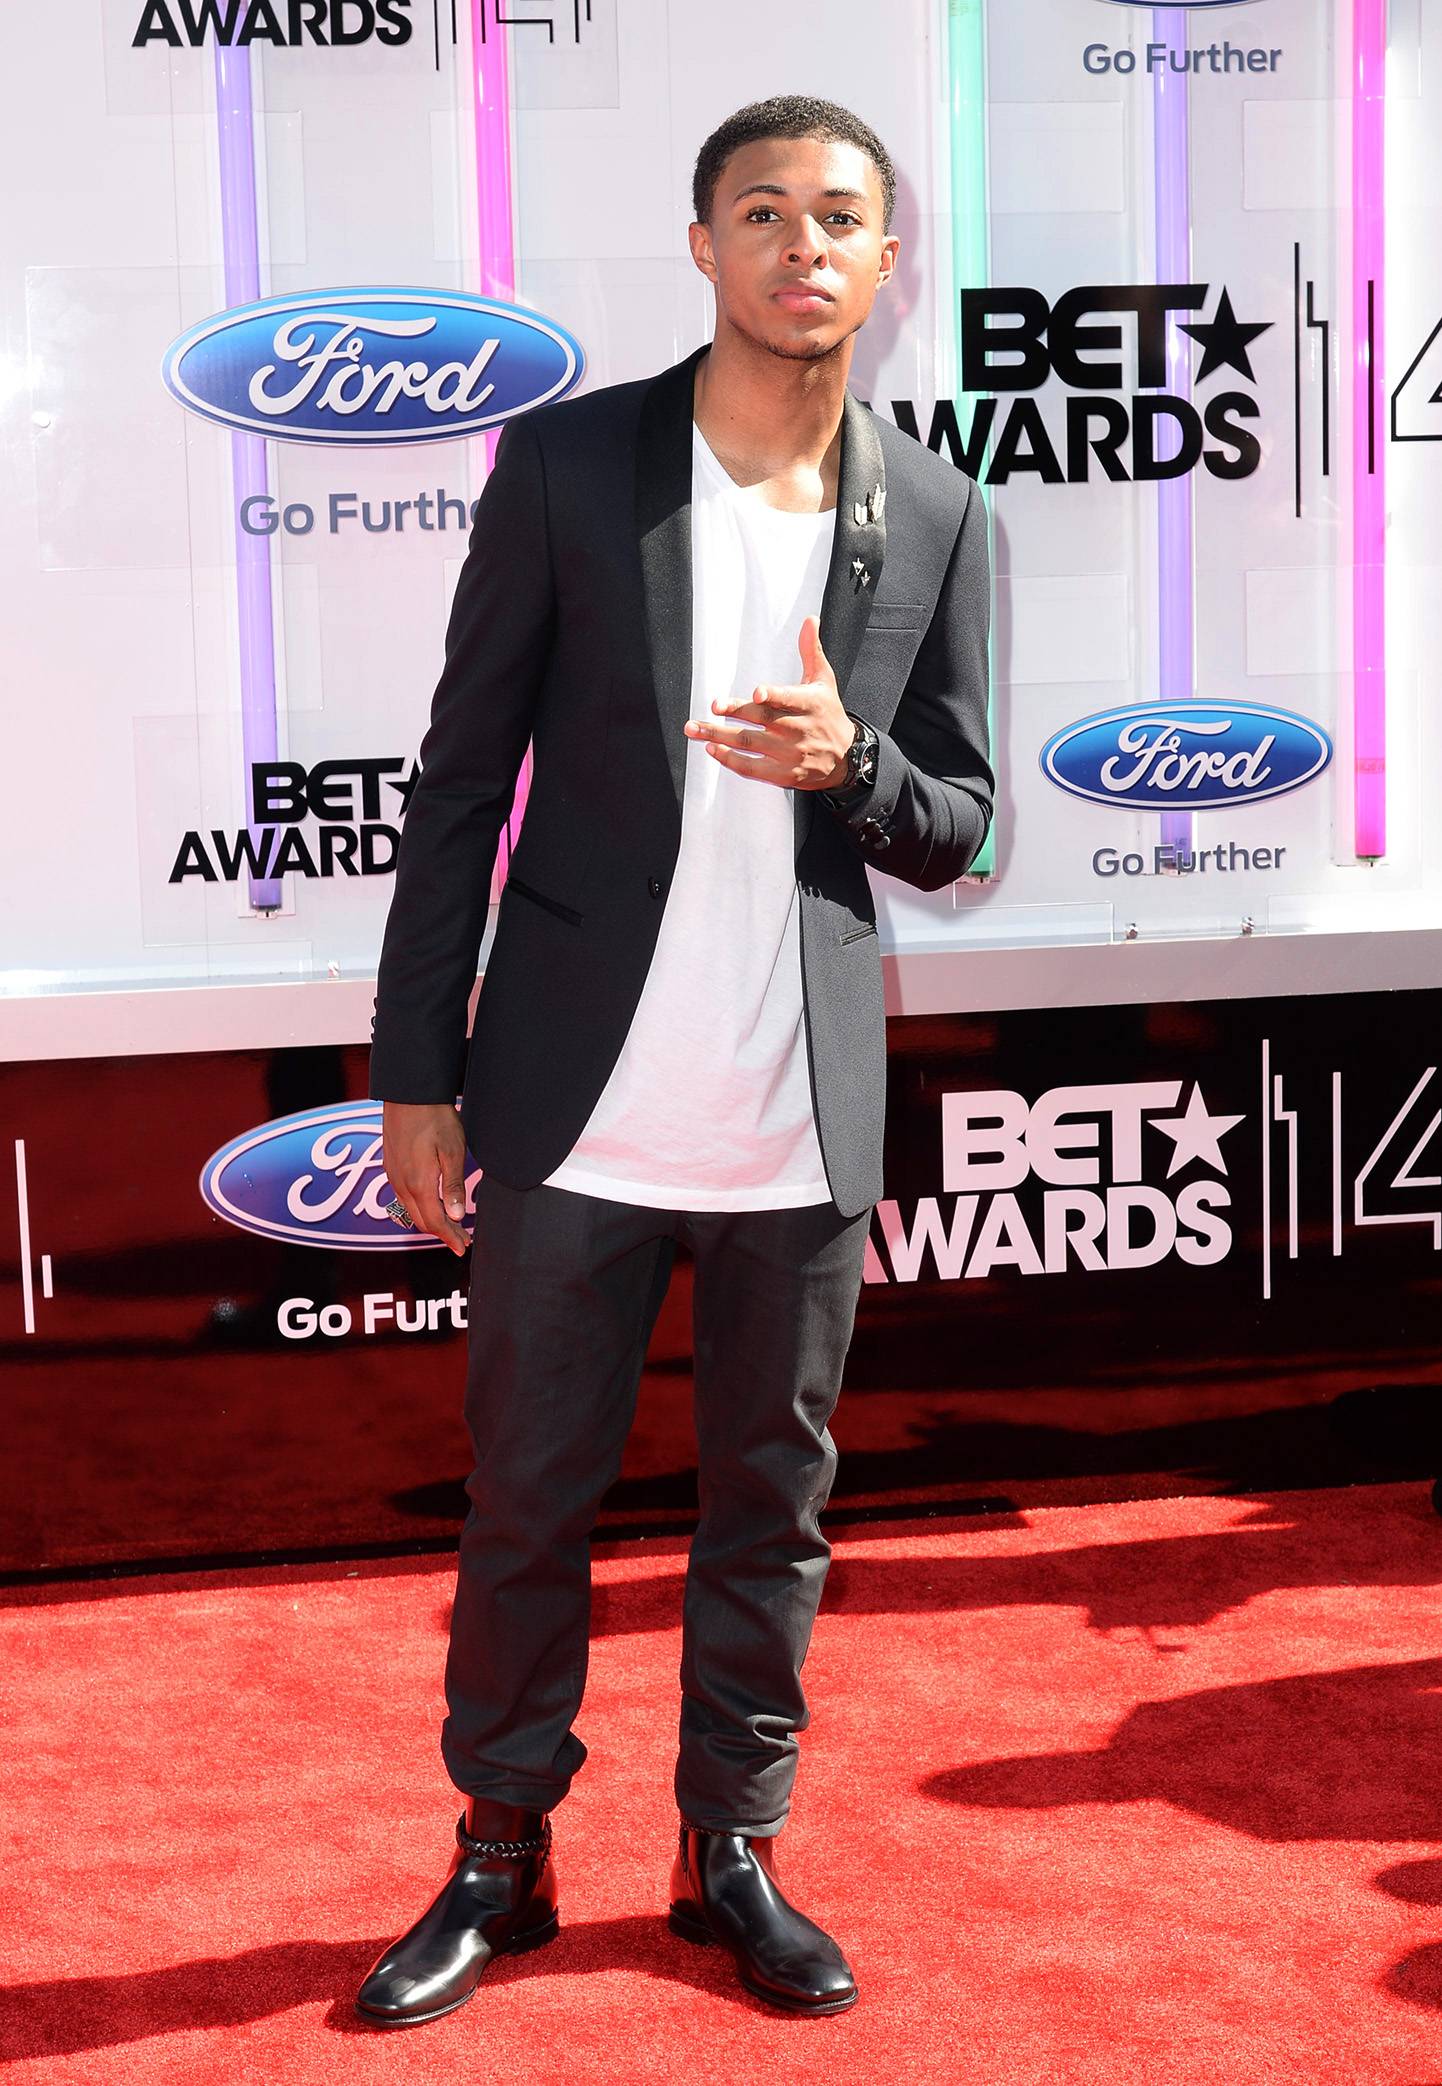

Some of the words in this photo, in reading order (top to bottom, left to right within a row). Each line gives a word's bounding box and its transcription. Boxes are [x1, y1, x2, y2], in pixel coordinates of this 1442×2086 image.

[132, 0, 413, 47] AWARDS
[1083, 43, 1136, 74] Go
[1146, 41, 1282, 73] Further
[249, 313, 500, 415] Ford
[960, 284, 1209, 392] BET
[858, 391, 1261, 485] WARDS
[239, 495, 315, 536] Go
[328, 488, 481, 534] Furth
[1100, 719, 1276, 792] Ford
[252, 757, 405, 824] BET
[168, 823, 402, 883] AWARD
[1092, 847, 1144, 877] Go
[1154, 841, 1286, 875] Further
[942, 1080, 1183, 1193] BET
[863, 1180, 1232, 1284] WARDS
[277, 1297, 352, 1339] Go
[363, 1290, 469, 1335] Furt
